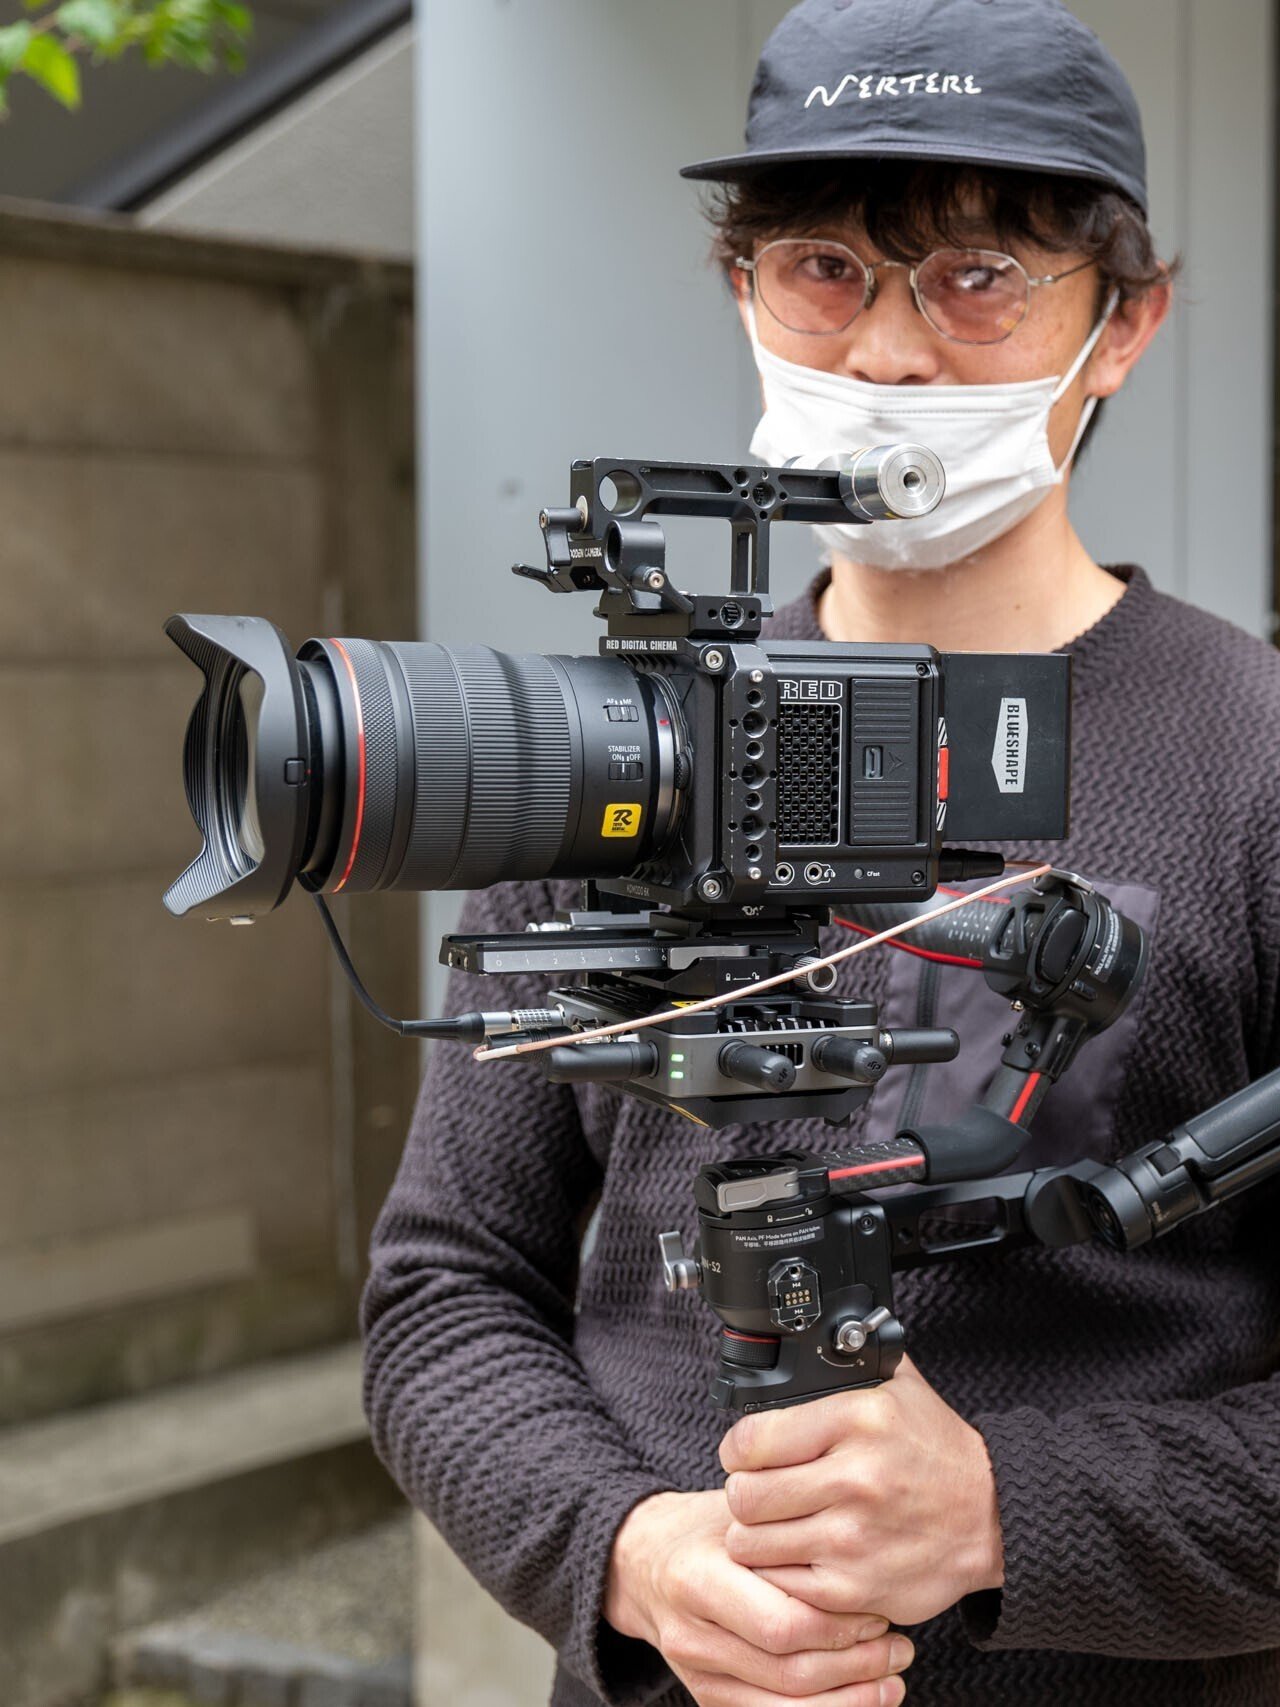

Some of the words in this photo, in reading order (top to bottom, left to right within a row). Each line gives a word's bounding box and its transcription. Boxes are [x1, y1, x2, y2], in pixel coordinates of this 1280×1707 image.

[804, 72, 982, 108] NERTERE
[585, 547, 602, 558] CAMERA
[606, 640, 619, 650] RED
[621, 640, 648, 651] DIGITAL
[650, 641, 678, 651] CINEMA
[778, 679, 843, 700] RED
[608, 745, 641, 753] STABILIZER
[1005, 704, 1020, 785] BLUESHAPE
[613, 809, 633, 826] R
